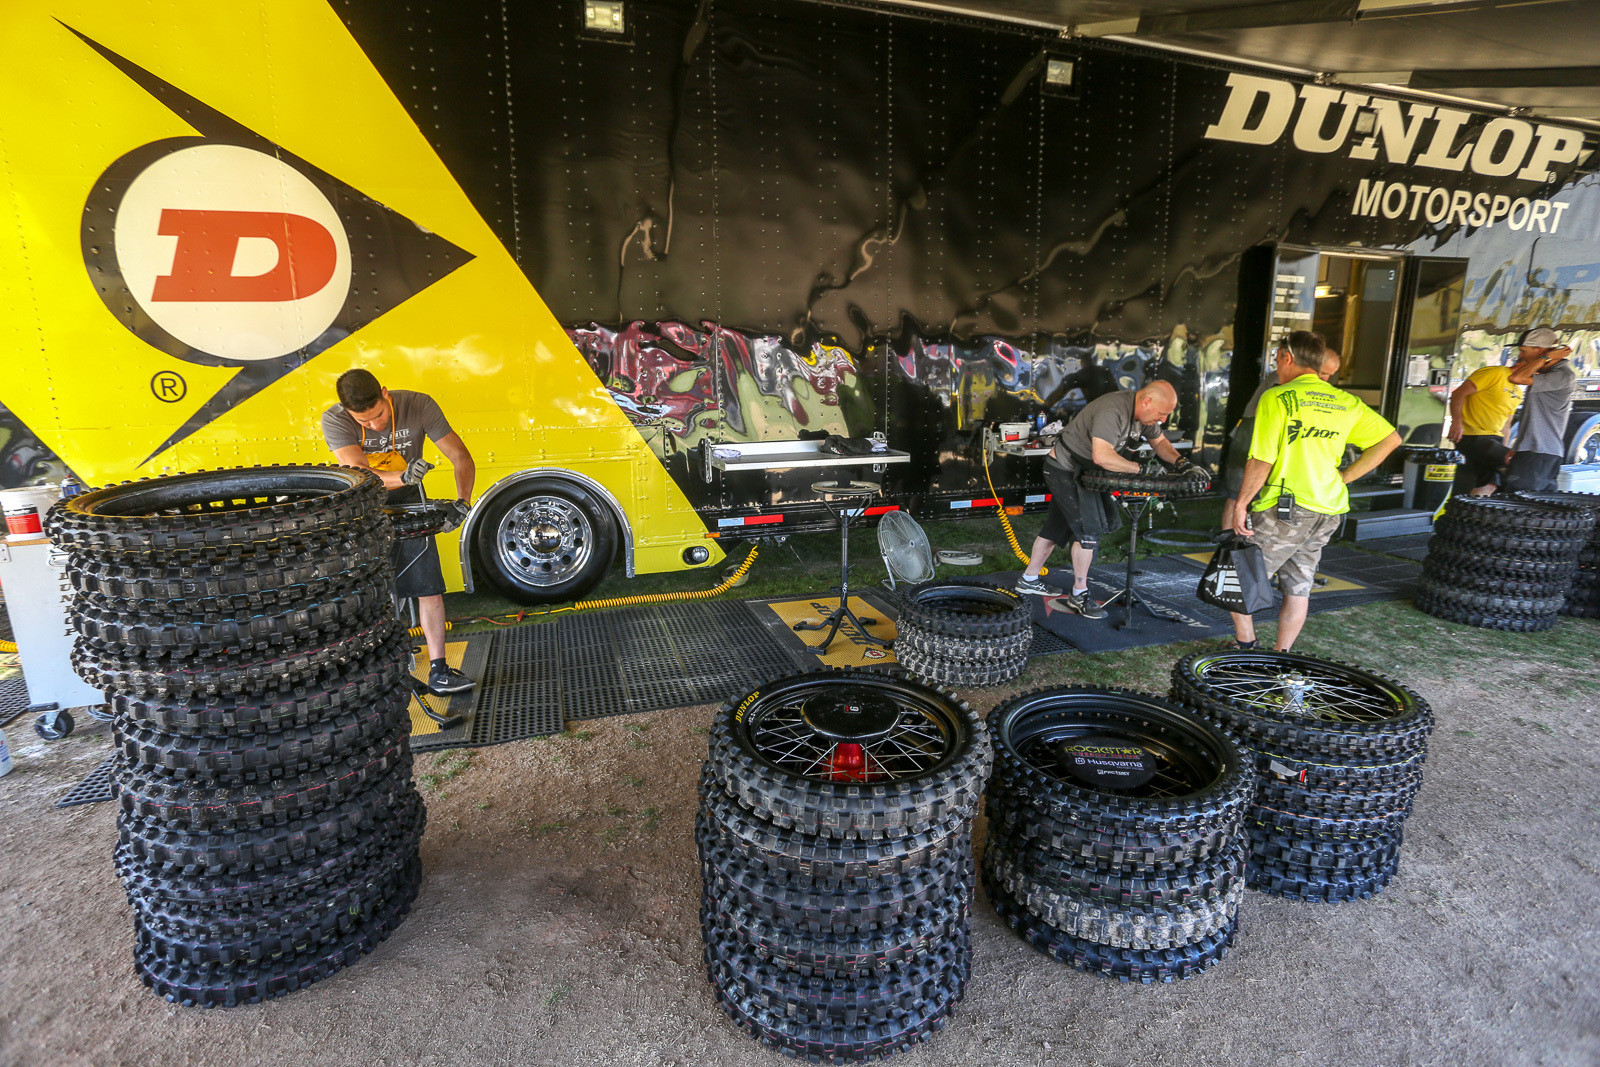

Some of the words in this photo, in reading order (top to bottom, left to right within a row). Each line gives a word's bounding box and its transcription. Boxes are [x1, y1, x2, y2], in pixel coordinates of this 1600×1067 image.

[1204, 72, 1585, 183] DUNLOP
[1351, 178, 1569, 234] MOTORSPORT
[151, 208, 337, 302] D
[735, 690, 760, 724] DUNLOP
[1087, 758, 1144, 768] Husqvarna
